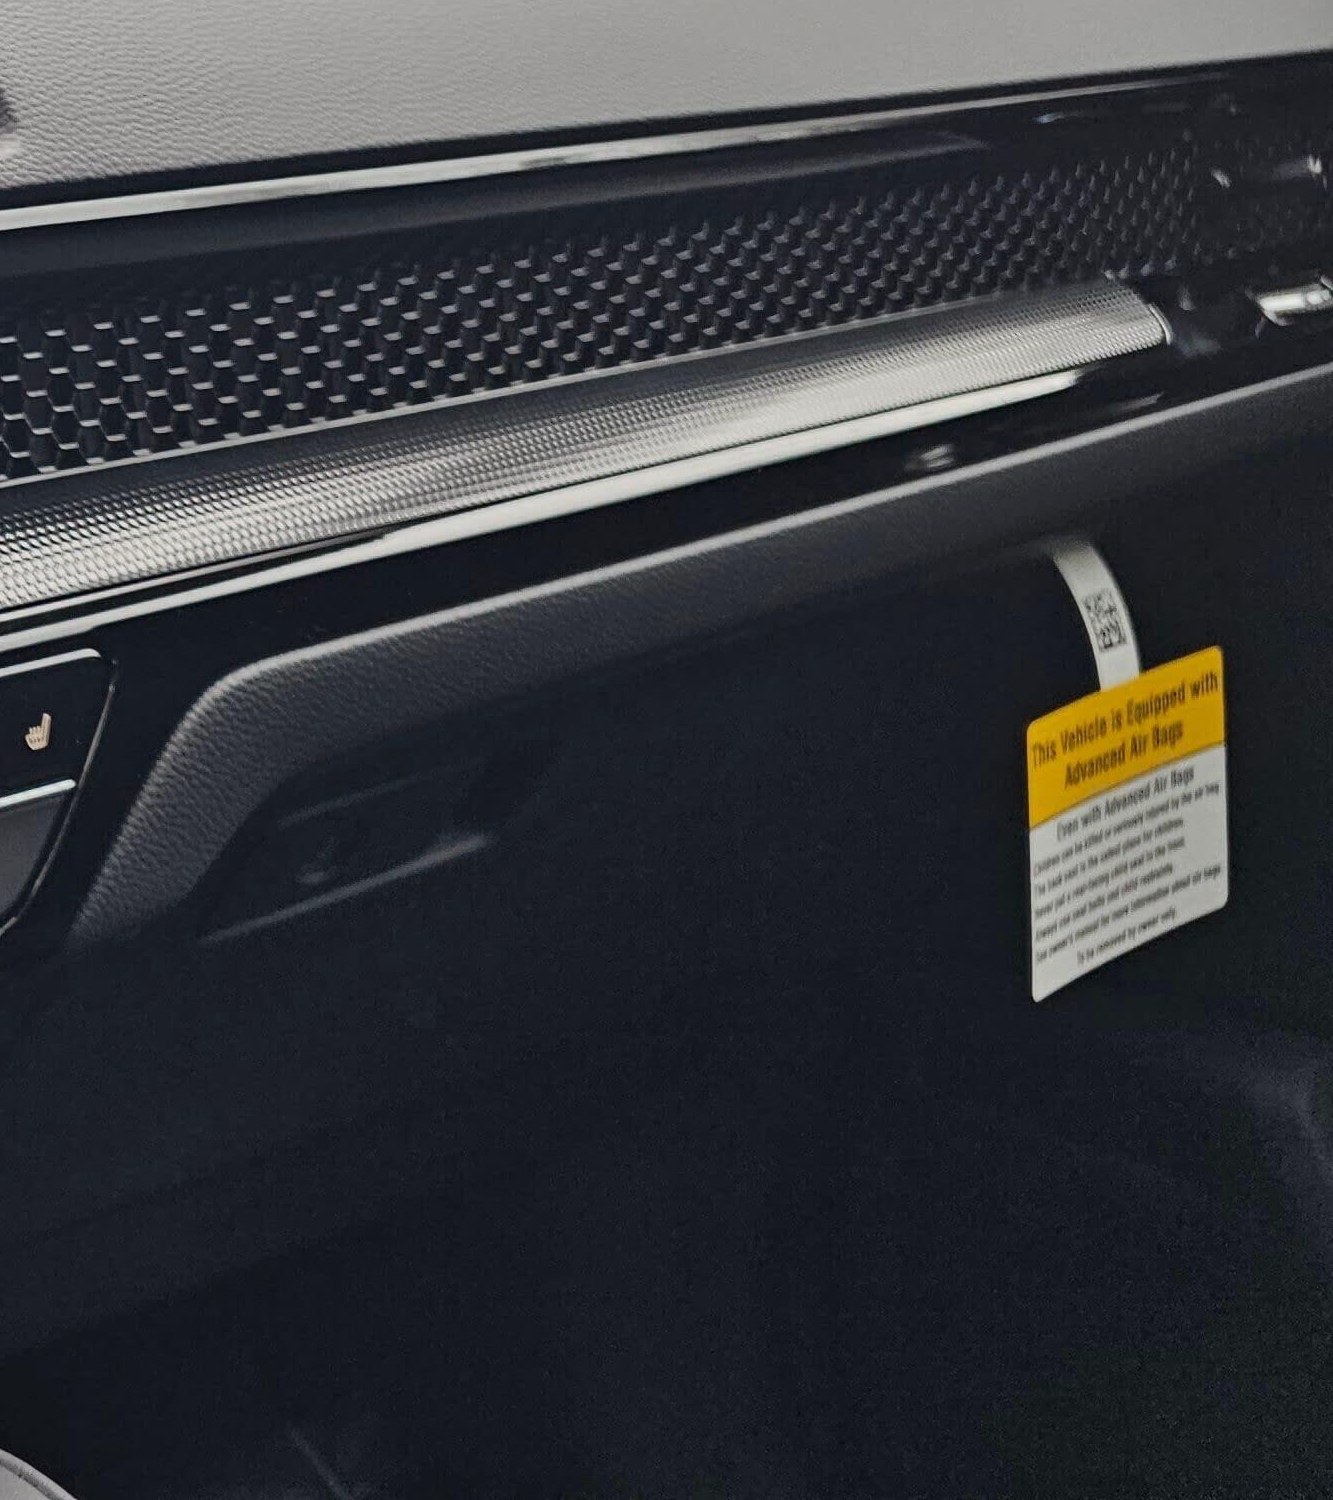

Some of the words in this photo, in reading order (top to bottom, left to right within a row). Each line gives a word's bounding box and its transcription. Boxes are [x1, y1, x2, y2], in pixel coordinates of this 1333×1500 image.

[1061, 715, 1107, 754] Vehicle
[1127, 680, 1186, 725] Equipped
[1190, 670, 1219, 699] with
[1064, 741, 1126, 789] Advanced
[1130, 733, 1148, 760] Air
[1152, 721, 1183, 749] Bags
